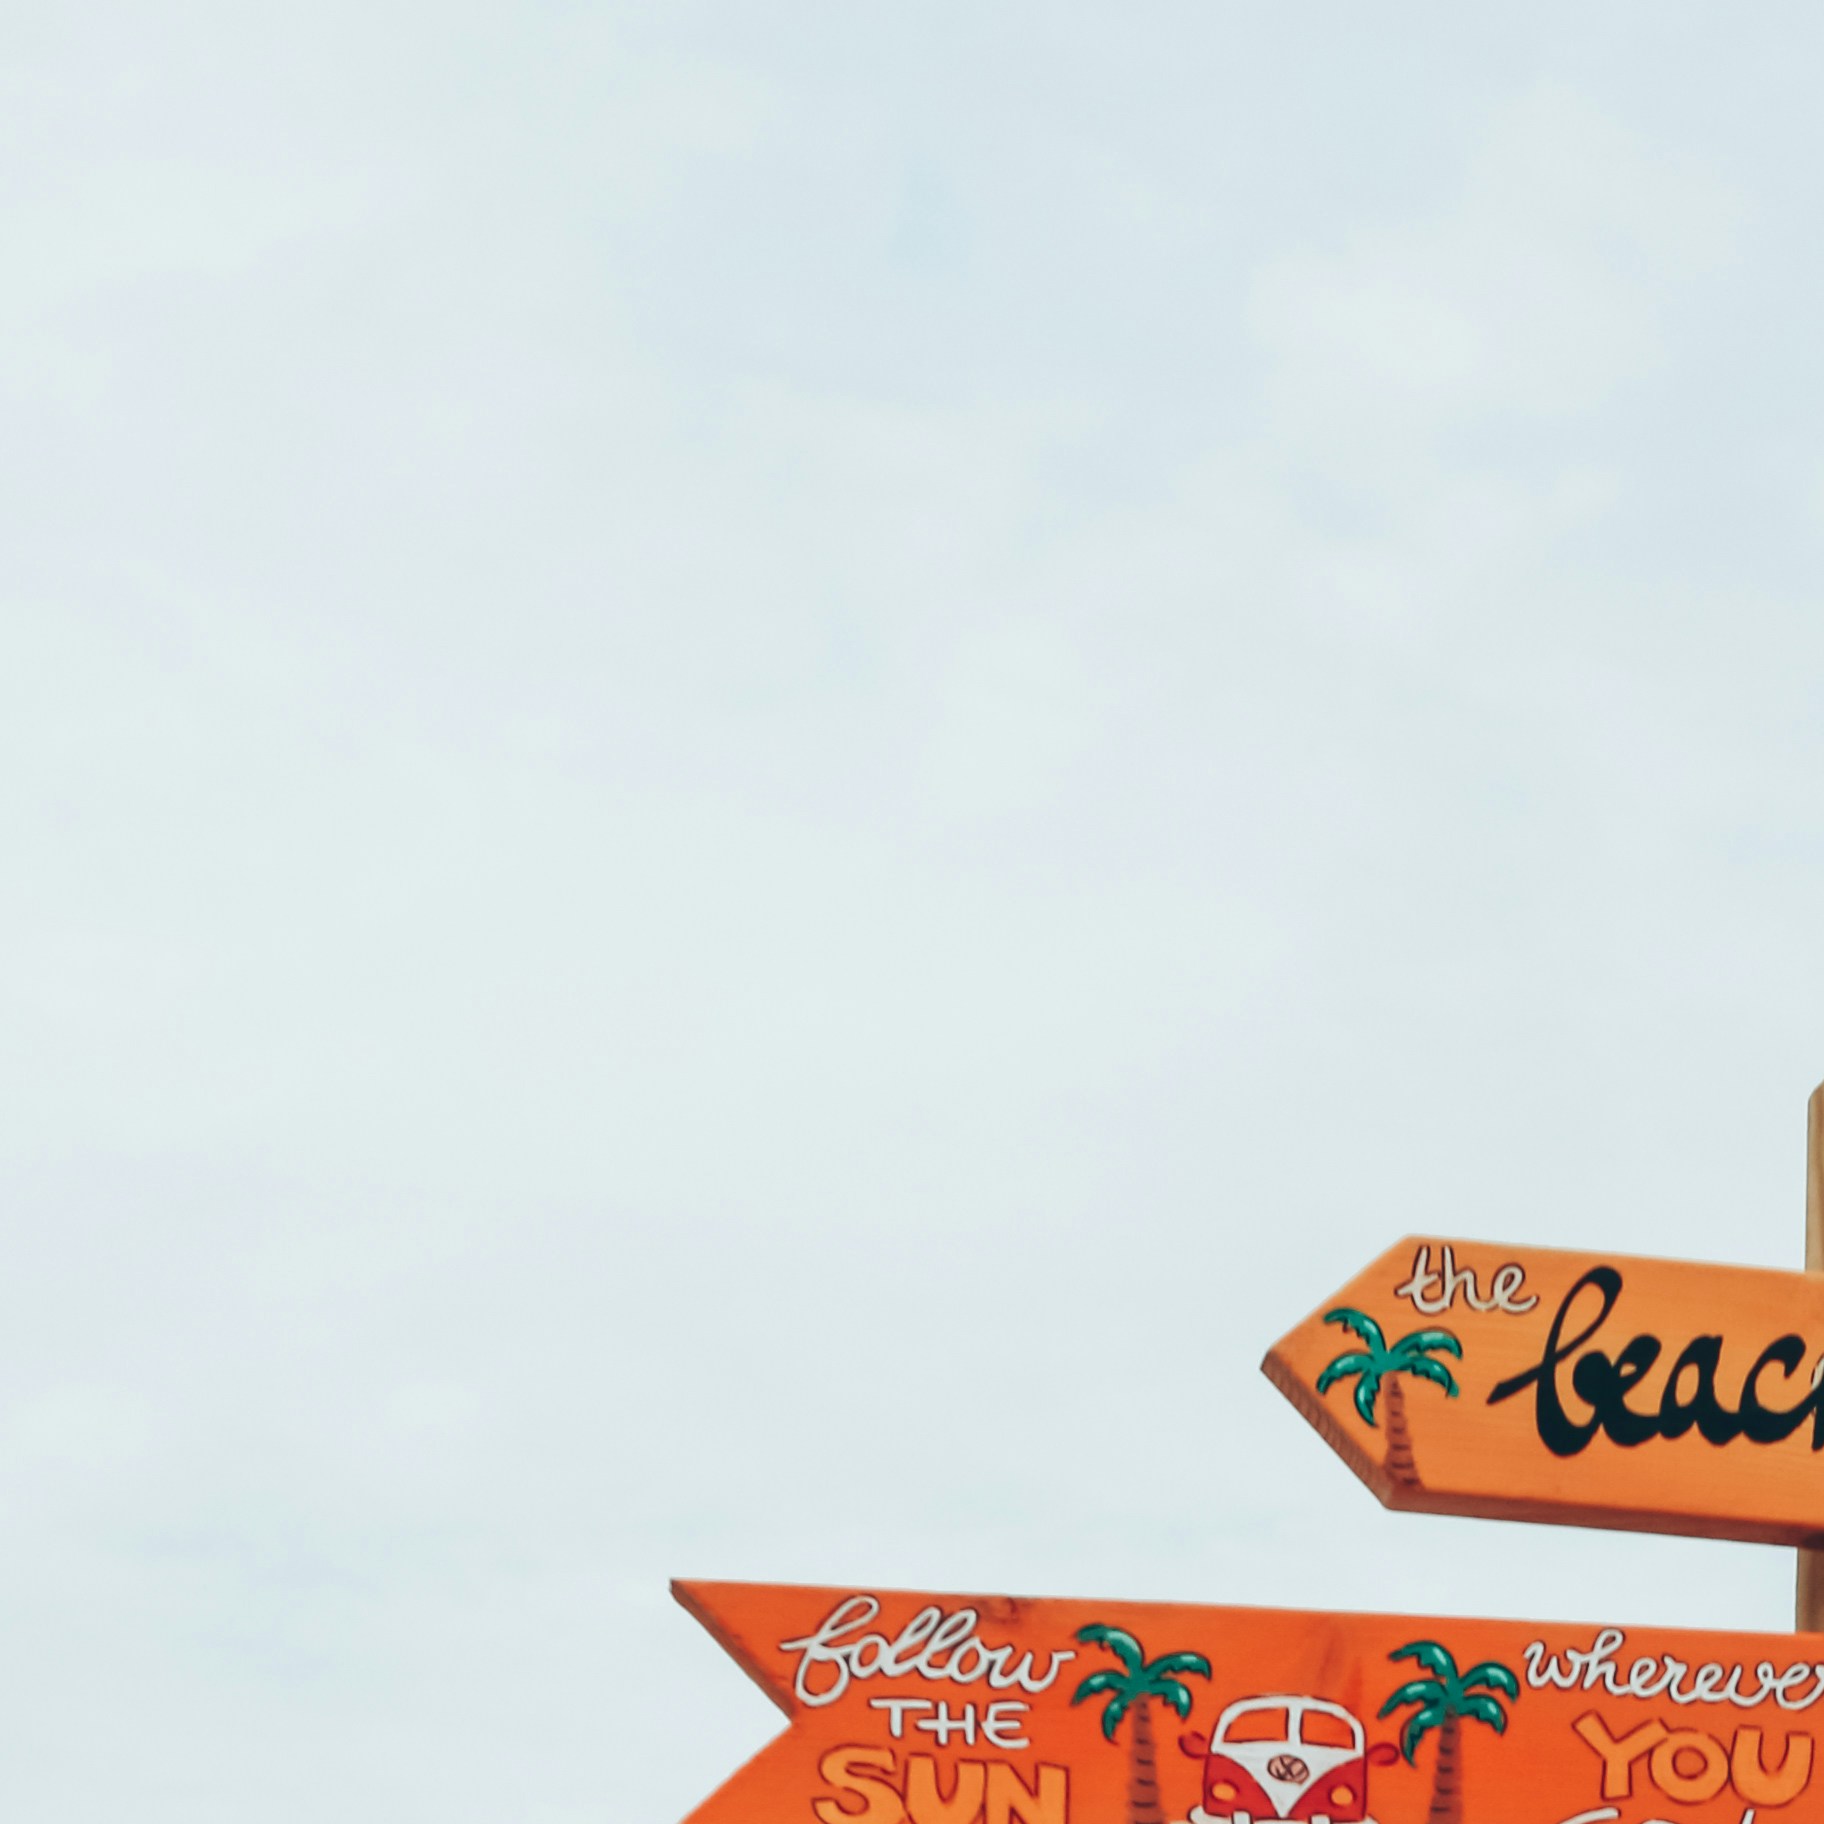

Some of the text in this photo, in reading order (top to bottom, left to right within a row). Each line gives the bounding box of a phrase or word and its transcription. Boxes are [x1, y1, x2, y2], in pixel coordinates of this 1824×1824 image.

[1397, 1246, 1541, 1315] the
[779, 1595, 1077, 1707] follow
[869, 1698, 1030, 1749] THE
[1571, 1710, 1814, 1807] YOU
